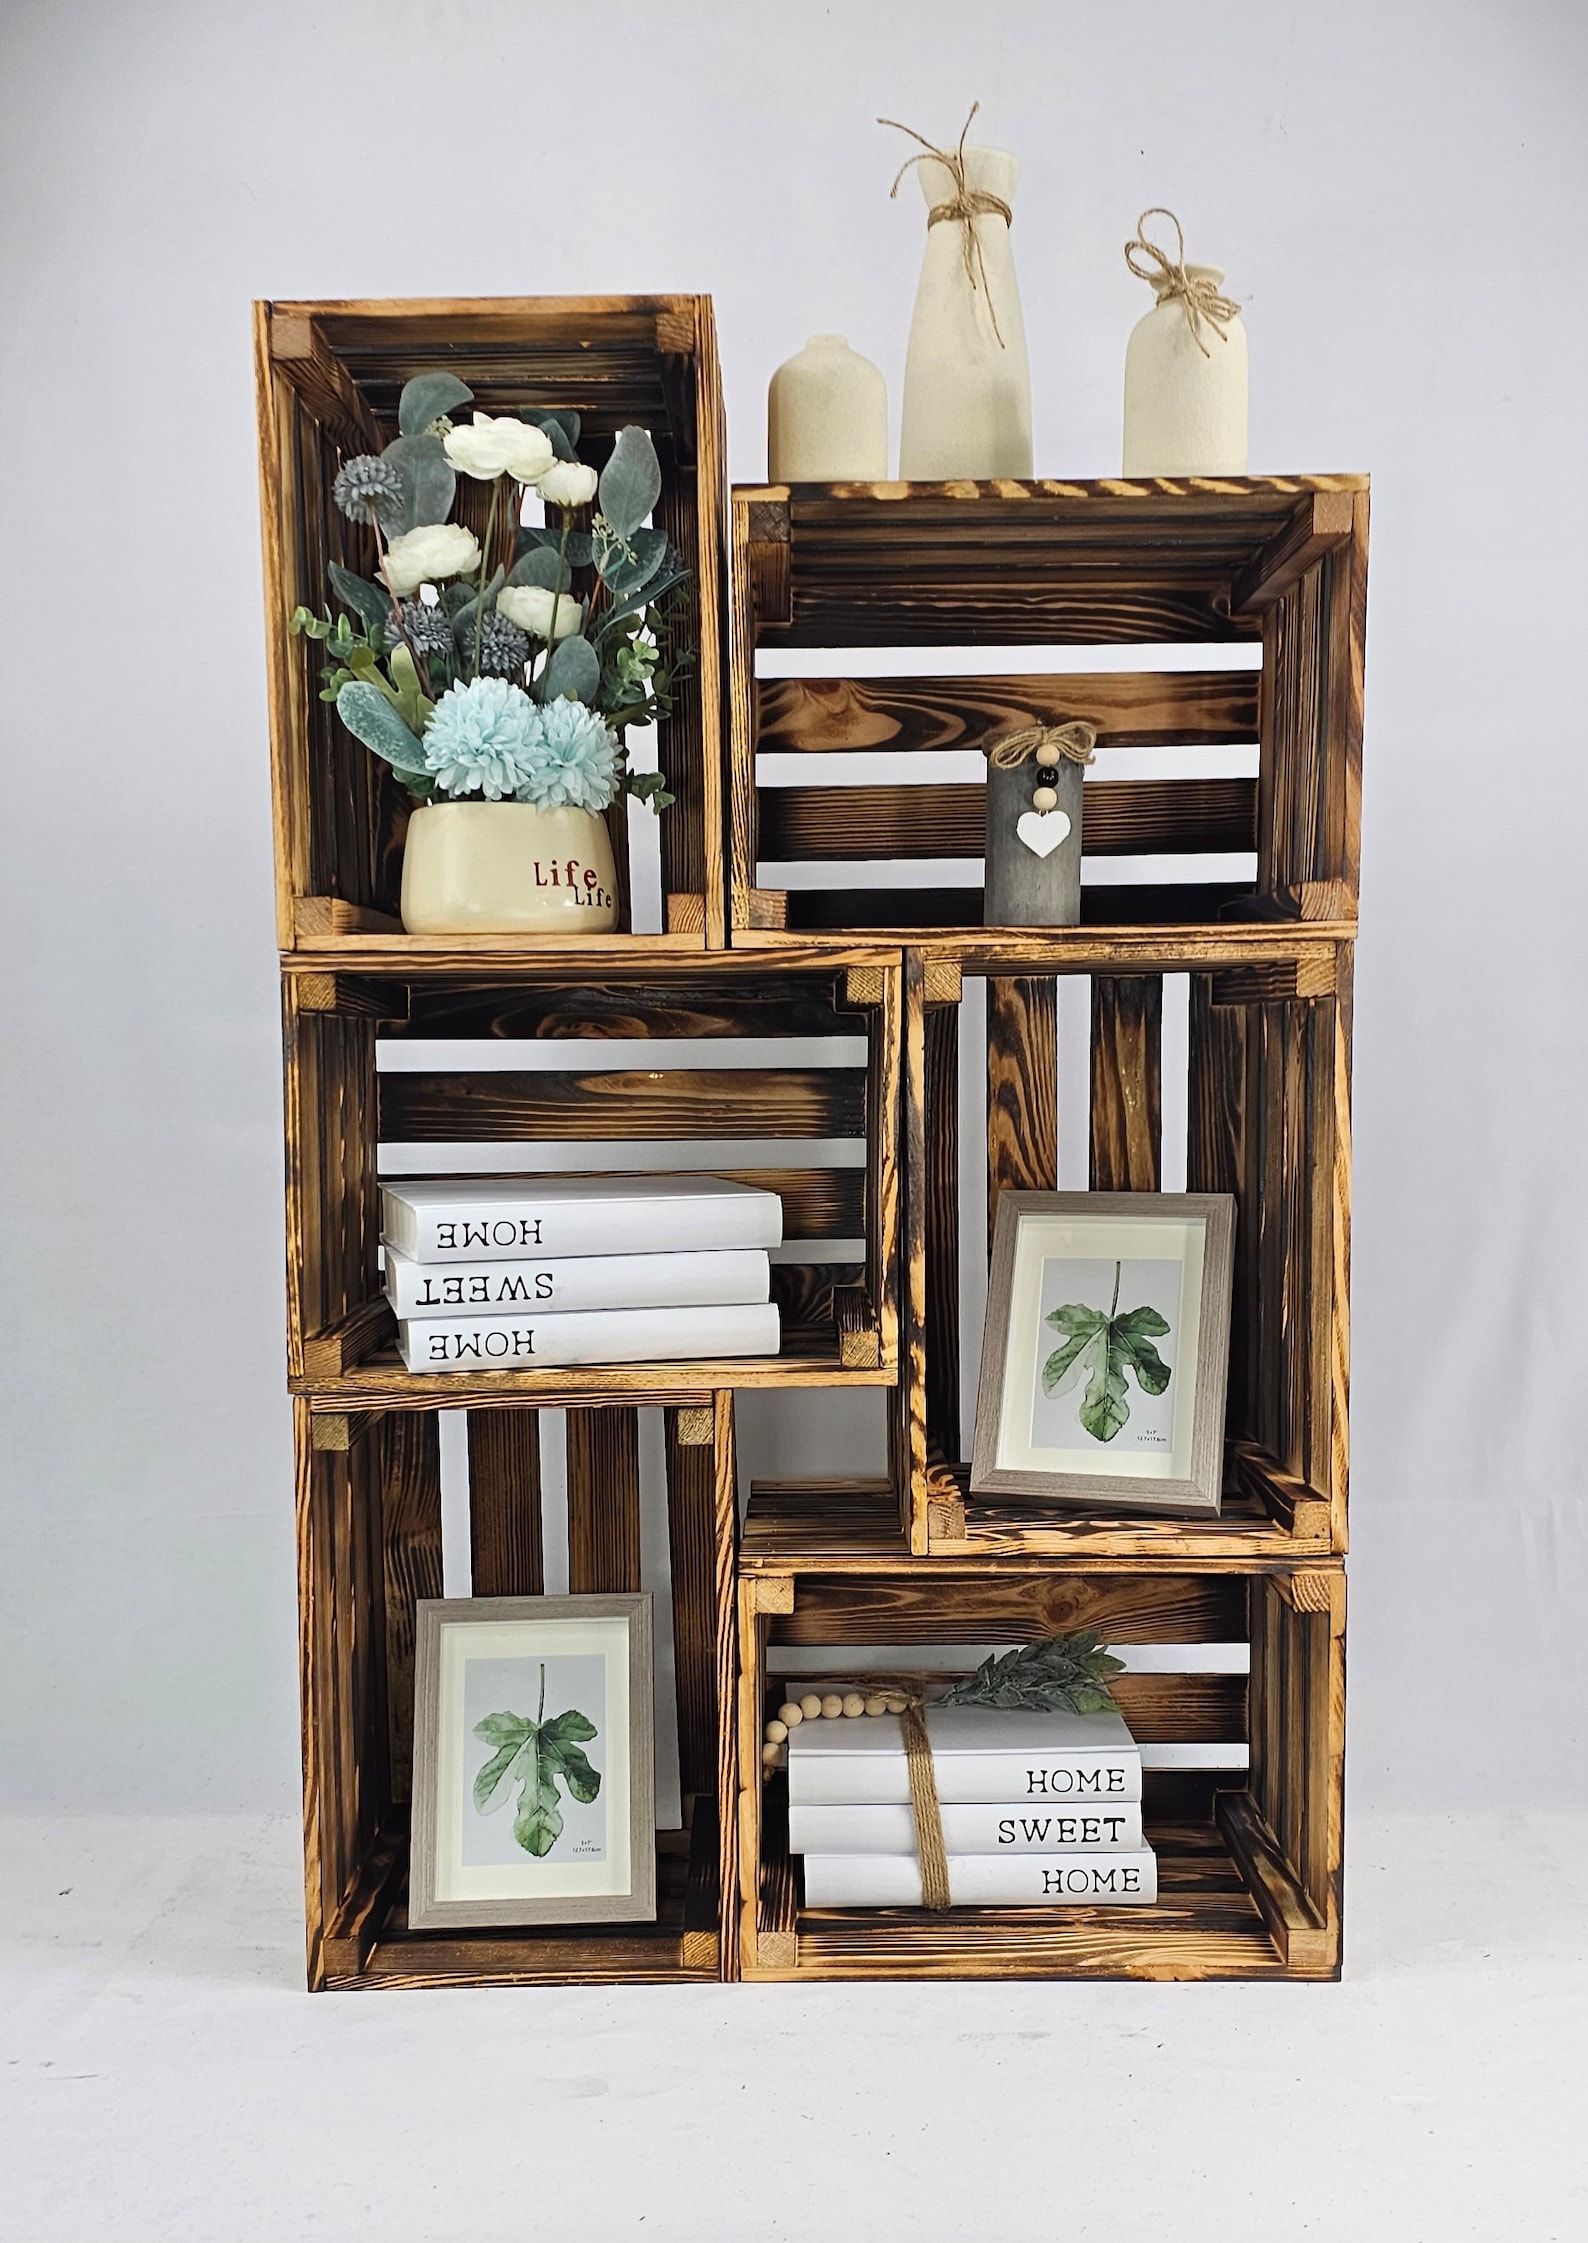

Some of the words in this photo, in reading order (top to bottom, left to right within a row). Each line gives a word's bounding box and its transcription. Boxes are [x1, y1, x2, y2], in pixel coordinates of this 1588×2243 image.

[533, 859, 598, 889] Life
[573, 885, 613, 908] Life
[436, 1219, 543, 1249] HOME
[415, 1272, 554, 1306] SWEET
[428, 1329, 536, 1360] HOME
[1026, 1768, 1125, 1794] HOME
[998, 1817, 1126, 1844] SWEET
[1041, 1868, 1141, 1894] HOME
